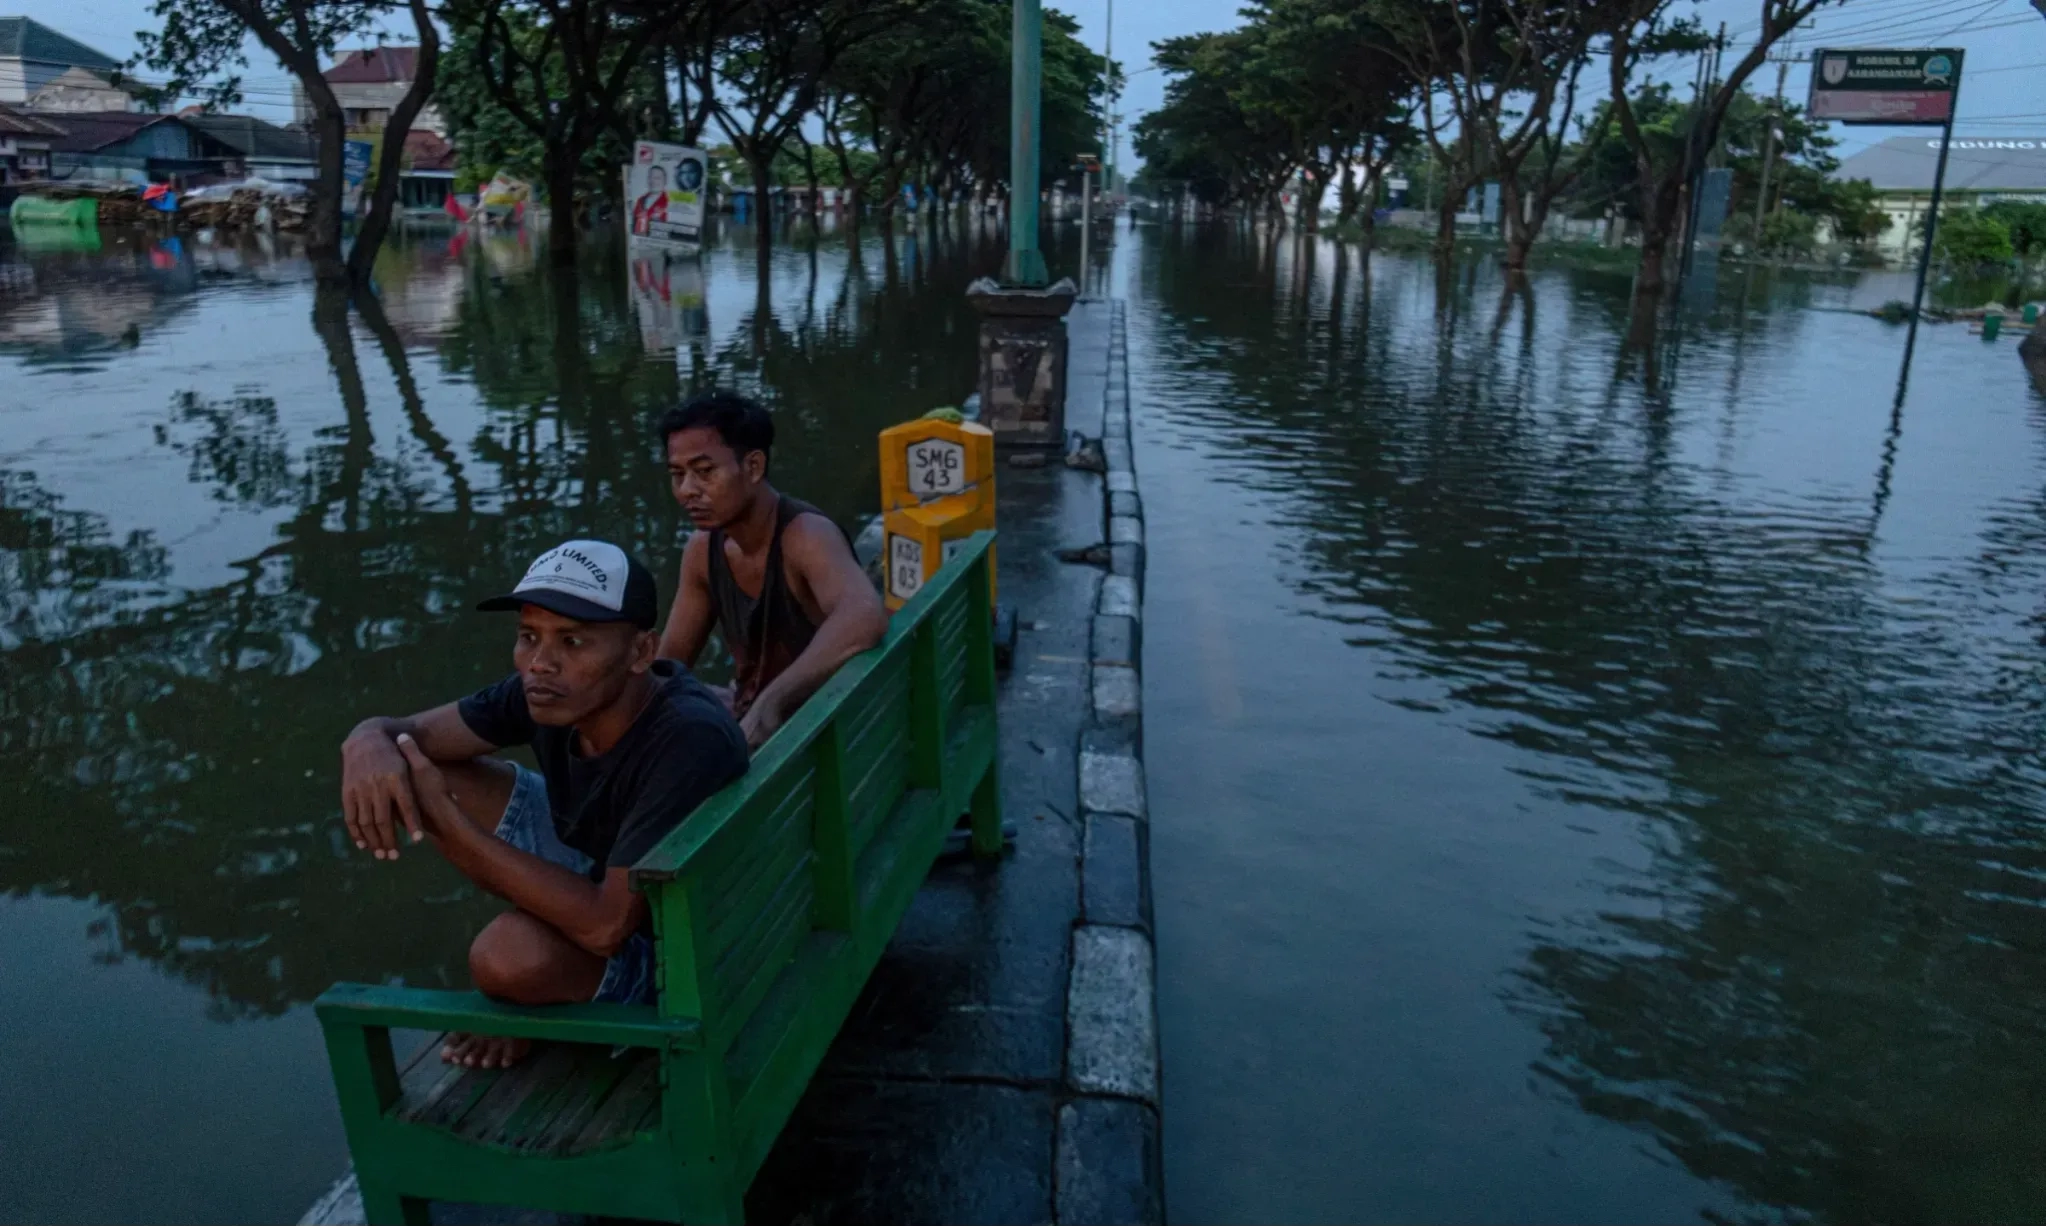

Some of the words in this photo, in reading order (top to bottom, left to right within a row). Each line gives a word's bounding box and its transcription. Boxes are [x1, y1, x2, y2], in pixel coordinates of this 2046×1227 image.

[1926, 140, 2037, 150] GEDUNG
[915, 448, 959, 470] SMG
[922, 468, 951, 490] 43
